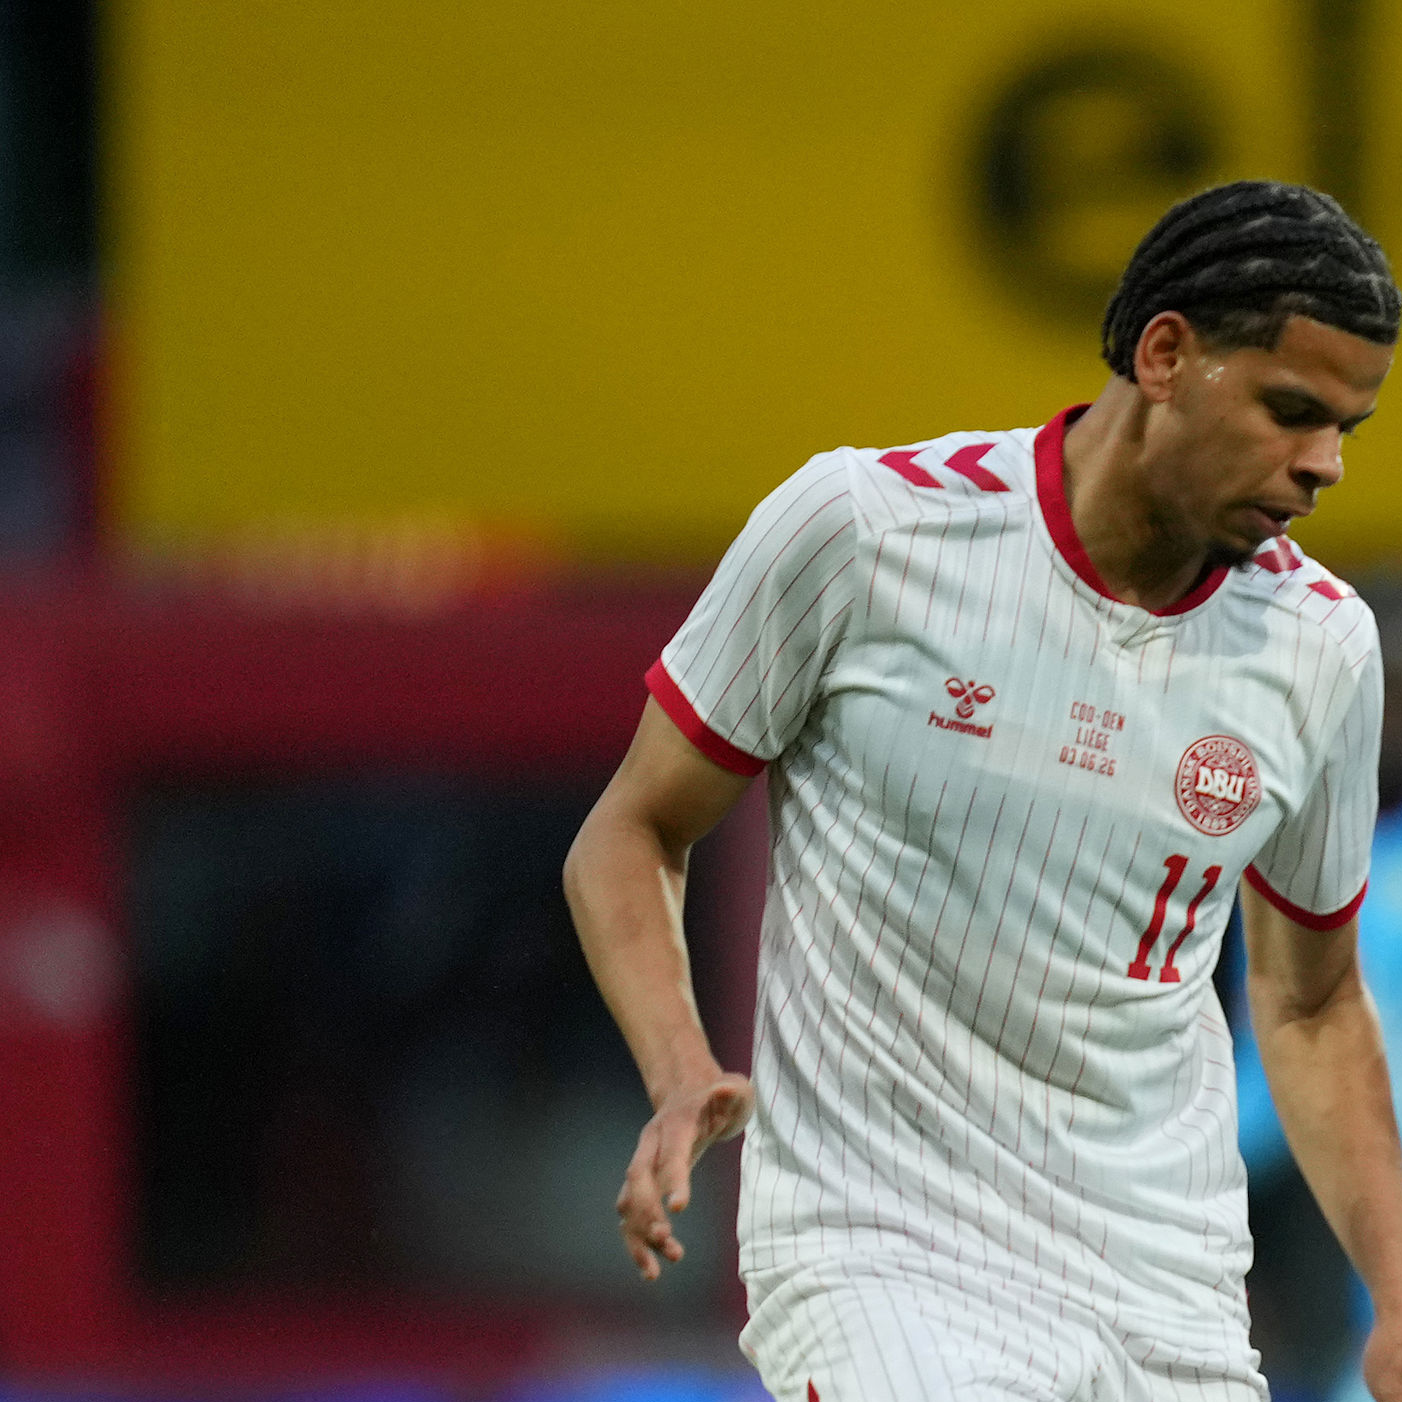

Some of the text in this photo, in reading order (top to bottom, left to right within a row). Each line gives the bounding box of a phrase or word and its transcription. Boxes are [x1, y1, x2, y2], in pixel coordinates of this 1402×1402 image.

[927, 710, 993, 739] hummel
[1059, 745, 1117, 777] 03.06.26
[1195, 765, 1245, 804] DBU
[1127, 853, 1223, 983] 11
